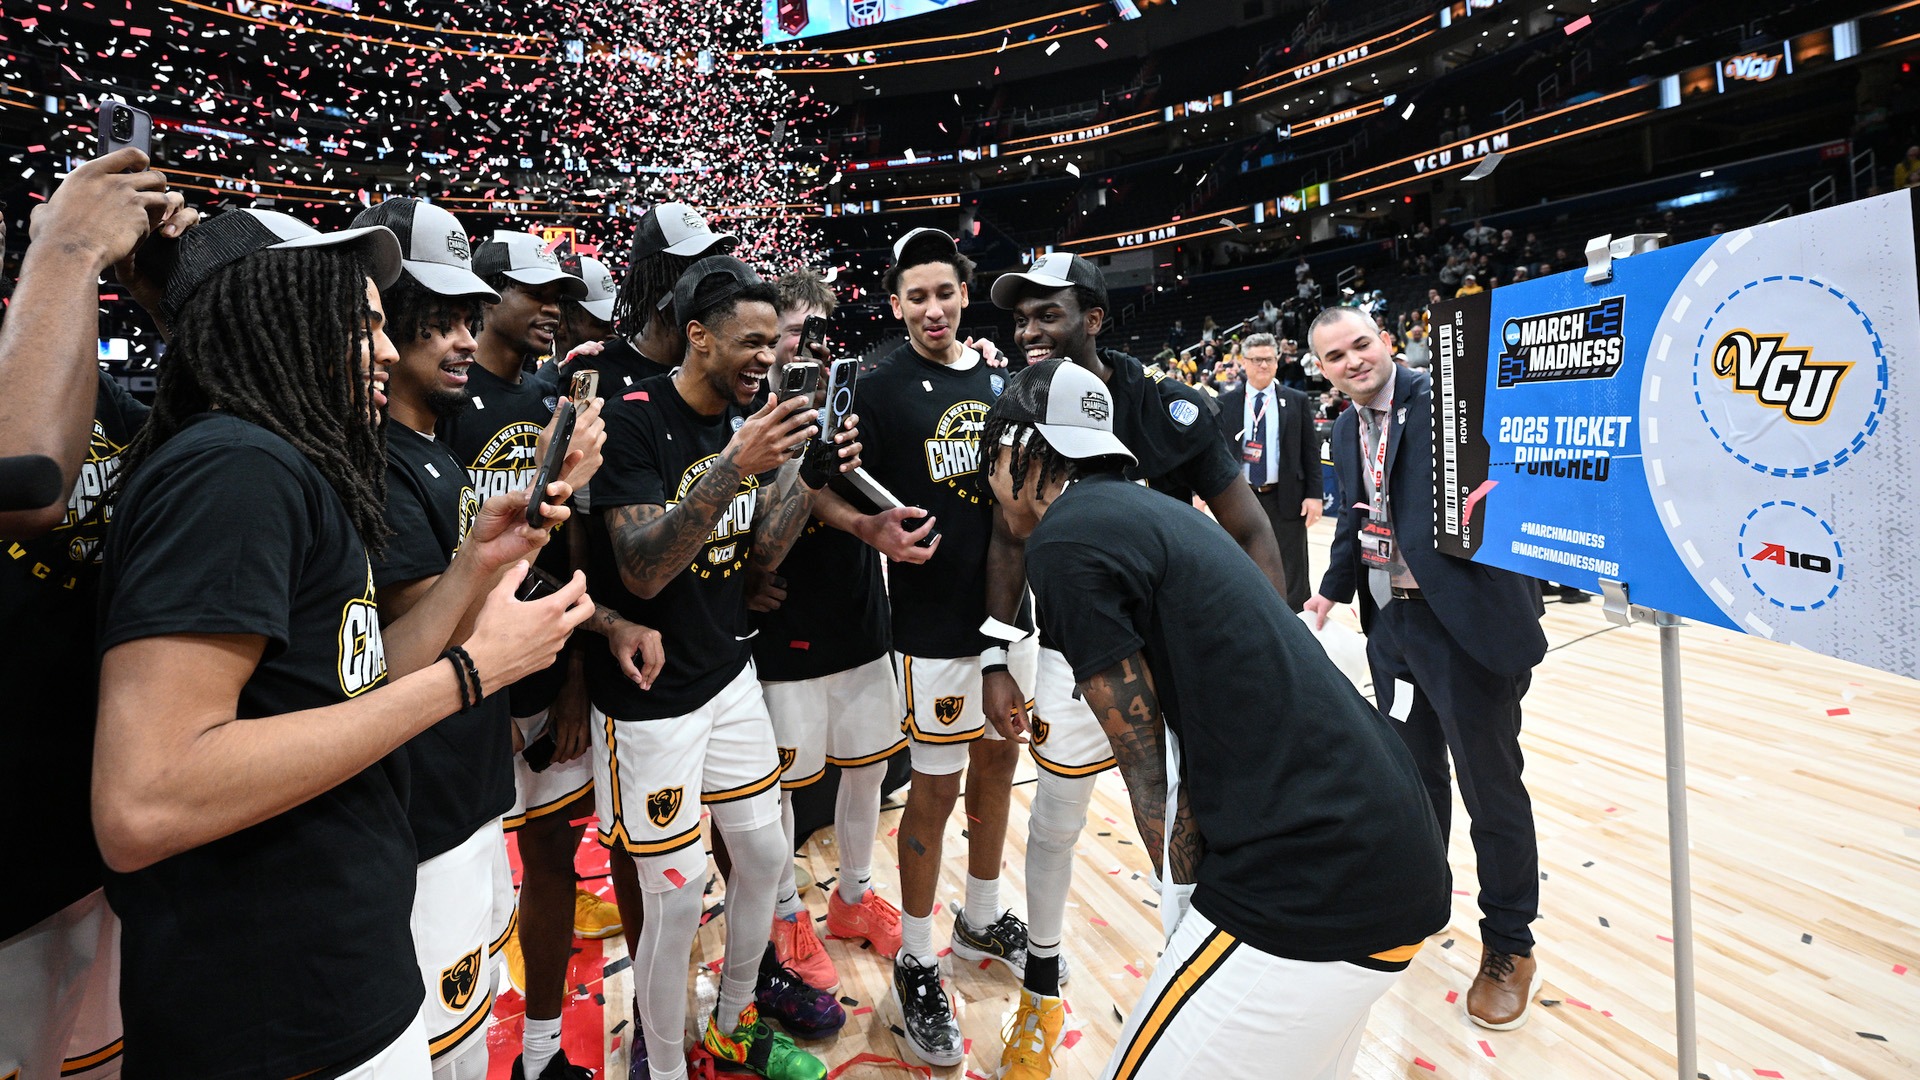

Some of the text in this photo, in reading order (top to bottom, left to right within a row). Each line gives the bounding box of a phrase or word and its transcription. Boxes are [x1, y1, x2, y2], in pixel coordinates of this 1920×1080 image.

[845, 50, 877, 65] VC
[1294, 46, 1369, 79] VCU RAMS
[1726, 53, 1782, 82] VCU
[1051, 126, 1110, 144] VCU RAMS
[1414, 133, 1509, 173] VCU RAM
[215, 179, 245, 191] VCU
[932, 196, 953, 205] VCU
[1117, 226, 1177, 247] VCU RAM
[1455, 310, 1464, 357] SEAT 25
[1521, 312, 1585, 347] MARCH
[1529, 337, 1620, 372] MADNESS
[1714, 331, 1848, 421] VCU
[1459, 400, 1468, 444] ROW 16
[1499, 416, 1632, 447] 2025 TICKET
[479, 440, 500, 465] 2025
[498, 425, 522, 442] MEN'S
[1515, 446, 1610, 482] PUNCHED
[948, 480, 979, 504] VCU
[1363, 523, 1391, 536] A10
[1462, 497, 1470, 549] SECON
[1521, 522, 1605, 549] #MARCHMADNESS
[708, 542, 737, 565] VCU
[1511, 541, 1619, 577] @MARCHMADNESSMBB
[1750, 541, 1831, 574] A10
[690, 562, 711, 579] CU
[1128, 694, 1152, 721] 4
